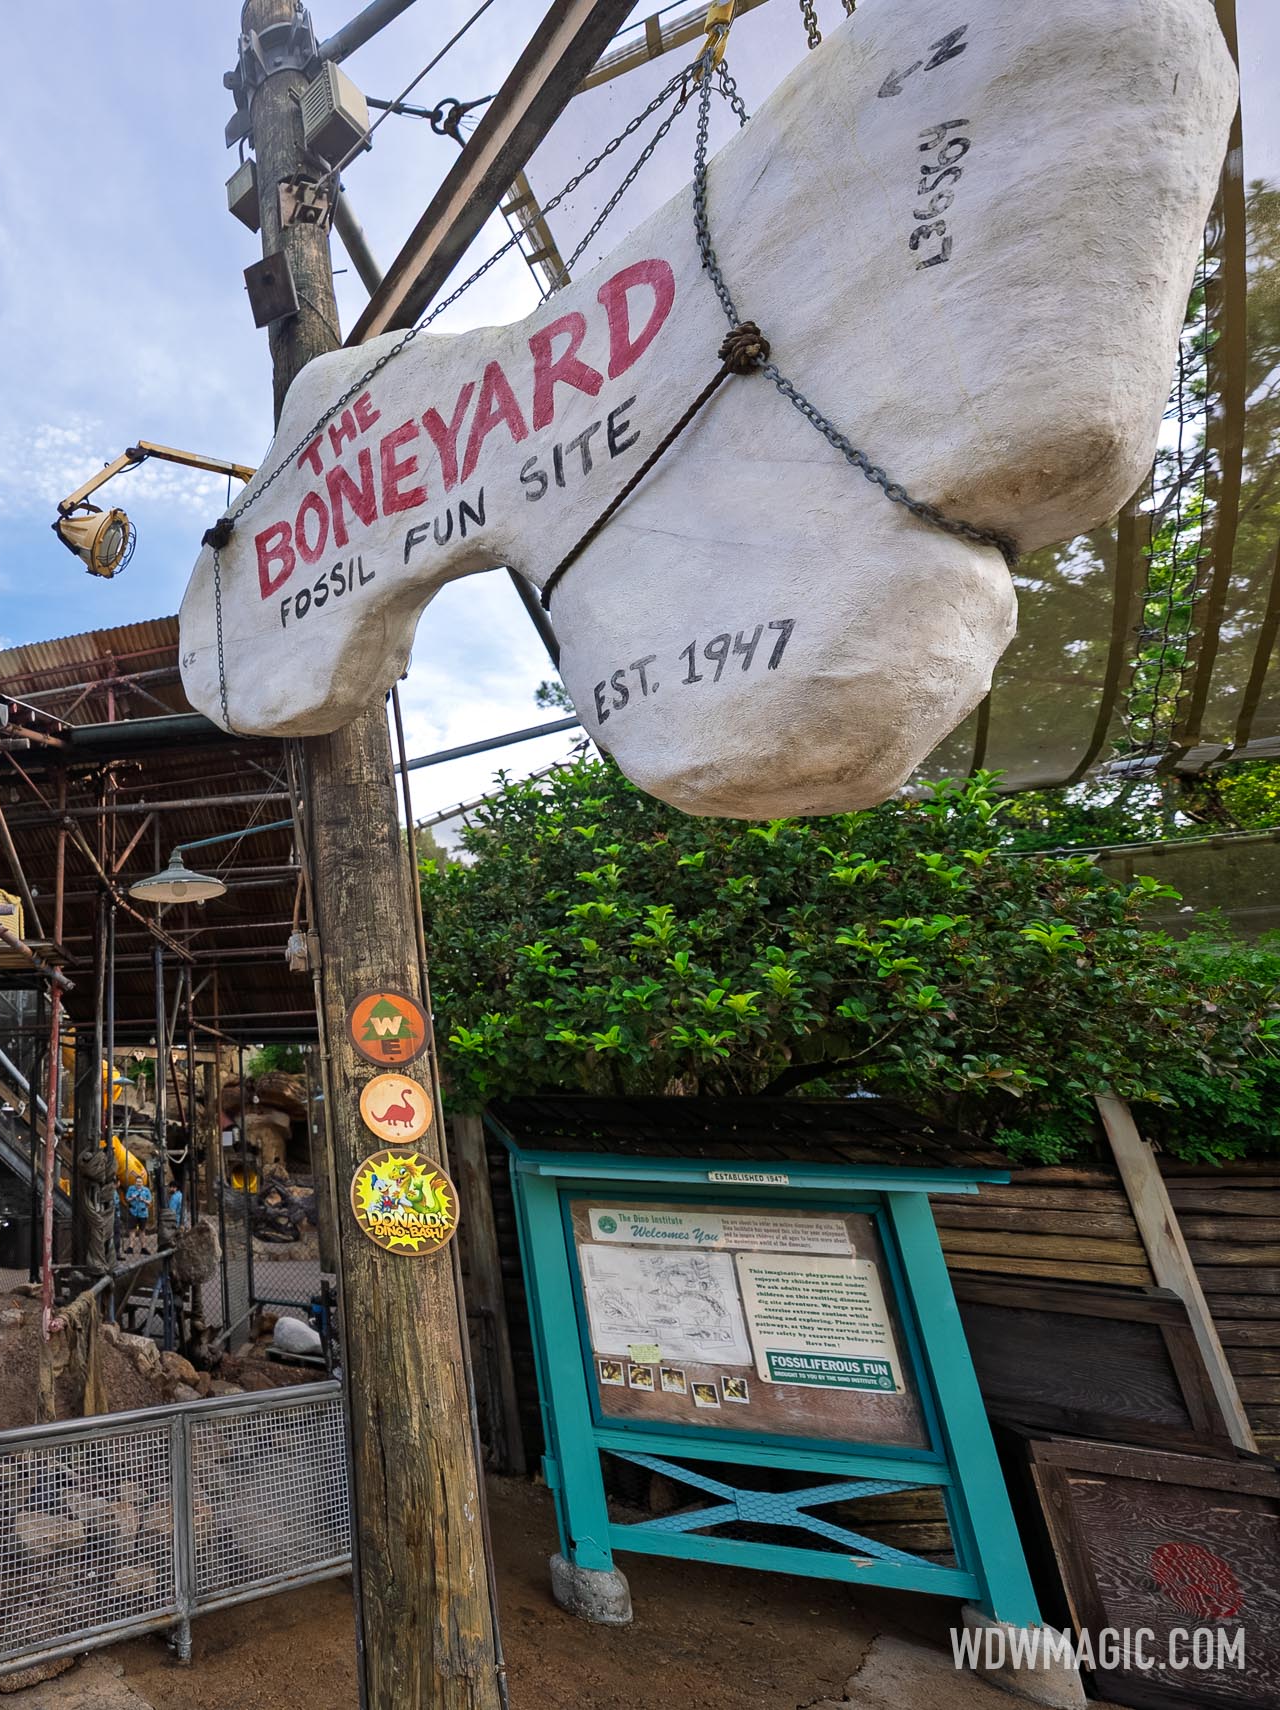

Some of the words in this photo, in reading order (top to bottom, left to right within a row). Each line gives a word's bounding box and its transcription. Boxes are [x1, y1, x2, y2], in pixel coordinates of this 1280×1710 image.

[254, 258, 676, 600] BONEYARD
[297, 391, 382, 477] THE
[280, 555, 376, 628] FOSSIL
[403, 486, 486, 564] FUN
[519, 394, 641, 502] SITE
[593, 654, 660, 725] EST.
[678, 618, 796, 685] 1947
[370, 1015, 403, 1036] W
[380, 1038, 402, 1055] E
[715, 1173, 764, 1182] ESTABLISHED
[367, 1210, 449, 1230] DONALD'S
[617, 1213, 631, 1222] The
[633, 1213, 650, 1223] Dino
[651, 1215, 683, 1225] Institute
[374, 1225, 445, 1239] DINO-BASH!
[630, 1225, 690, 1240] Welcomes
[692, 1228, 720, 1244] You
[771, 1355, 861, 1373] FOSSILIFEROUS
[863, 1363, 888, 1376] FUN
[774, 1371, 799, 1379] BROUGHT
[851, 1377, 878, 1385] INSTITUTE
